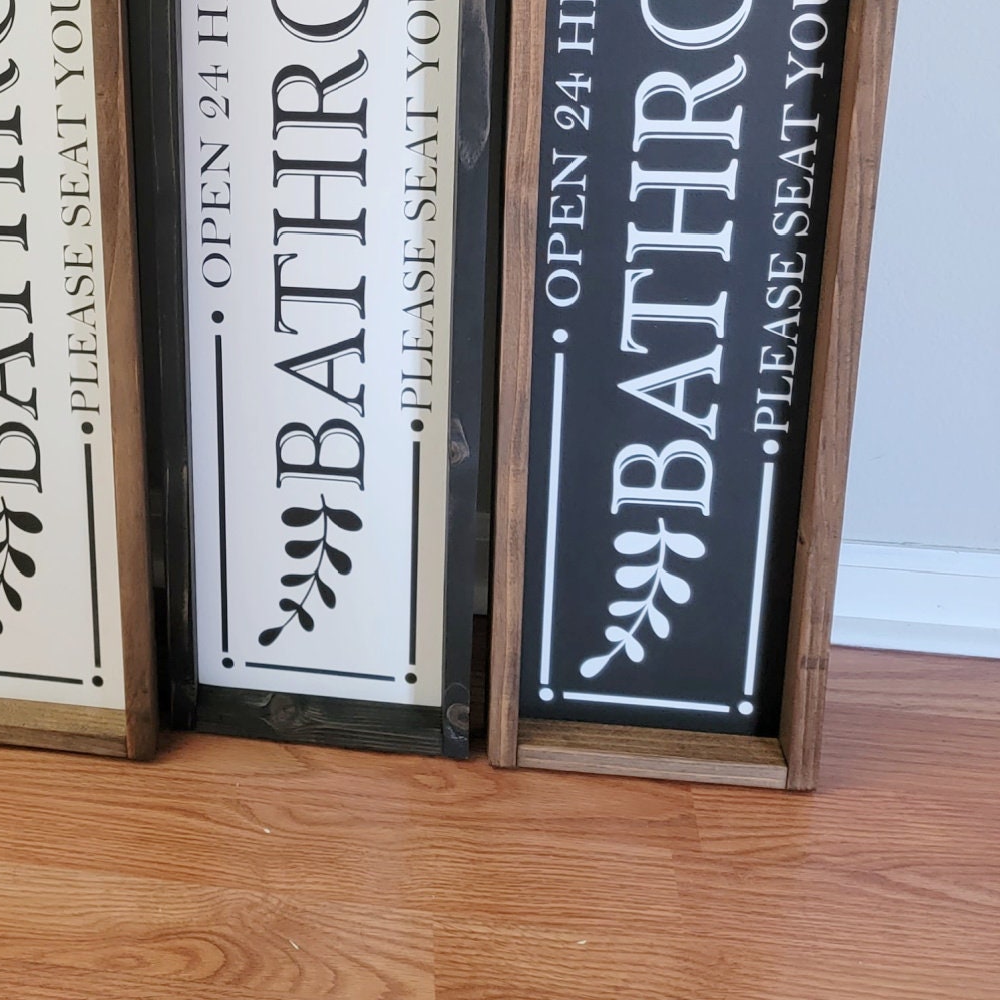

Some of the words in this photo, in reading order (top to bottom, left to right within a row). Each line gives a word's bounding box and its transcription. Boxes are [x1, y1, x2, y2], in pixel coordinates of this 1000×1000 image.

[198, 65, 229, 119] 24
[404, 99, 439, 222] SEAT
[554, 73, 591, 130] 24
[56, 104, 91, 226] SEAT
[200, 137, 231, 288] OPEN
[546, 148, 587, 307] OPEN
[772, 102, 819, 237] SEAT
[64, 244, 100, 414] PLEASE
[401, 238, 439, 418] PLEASE
[754, 252, 806, 440] PLEASE
